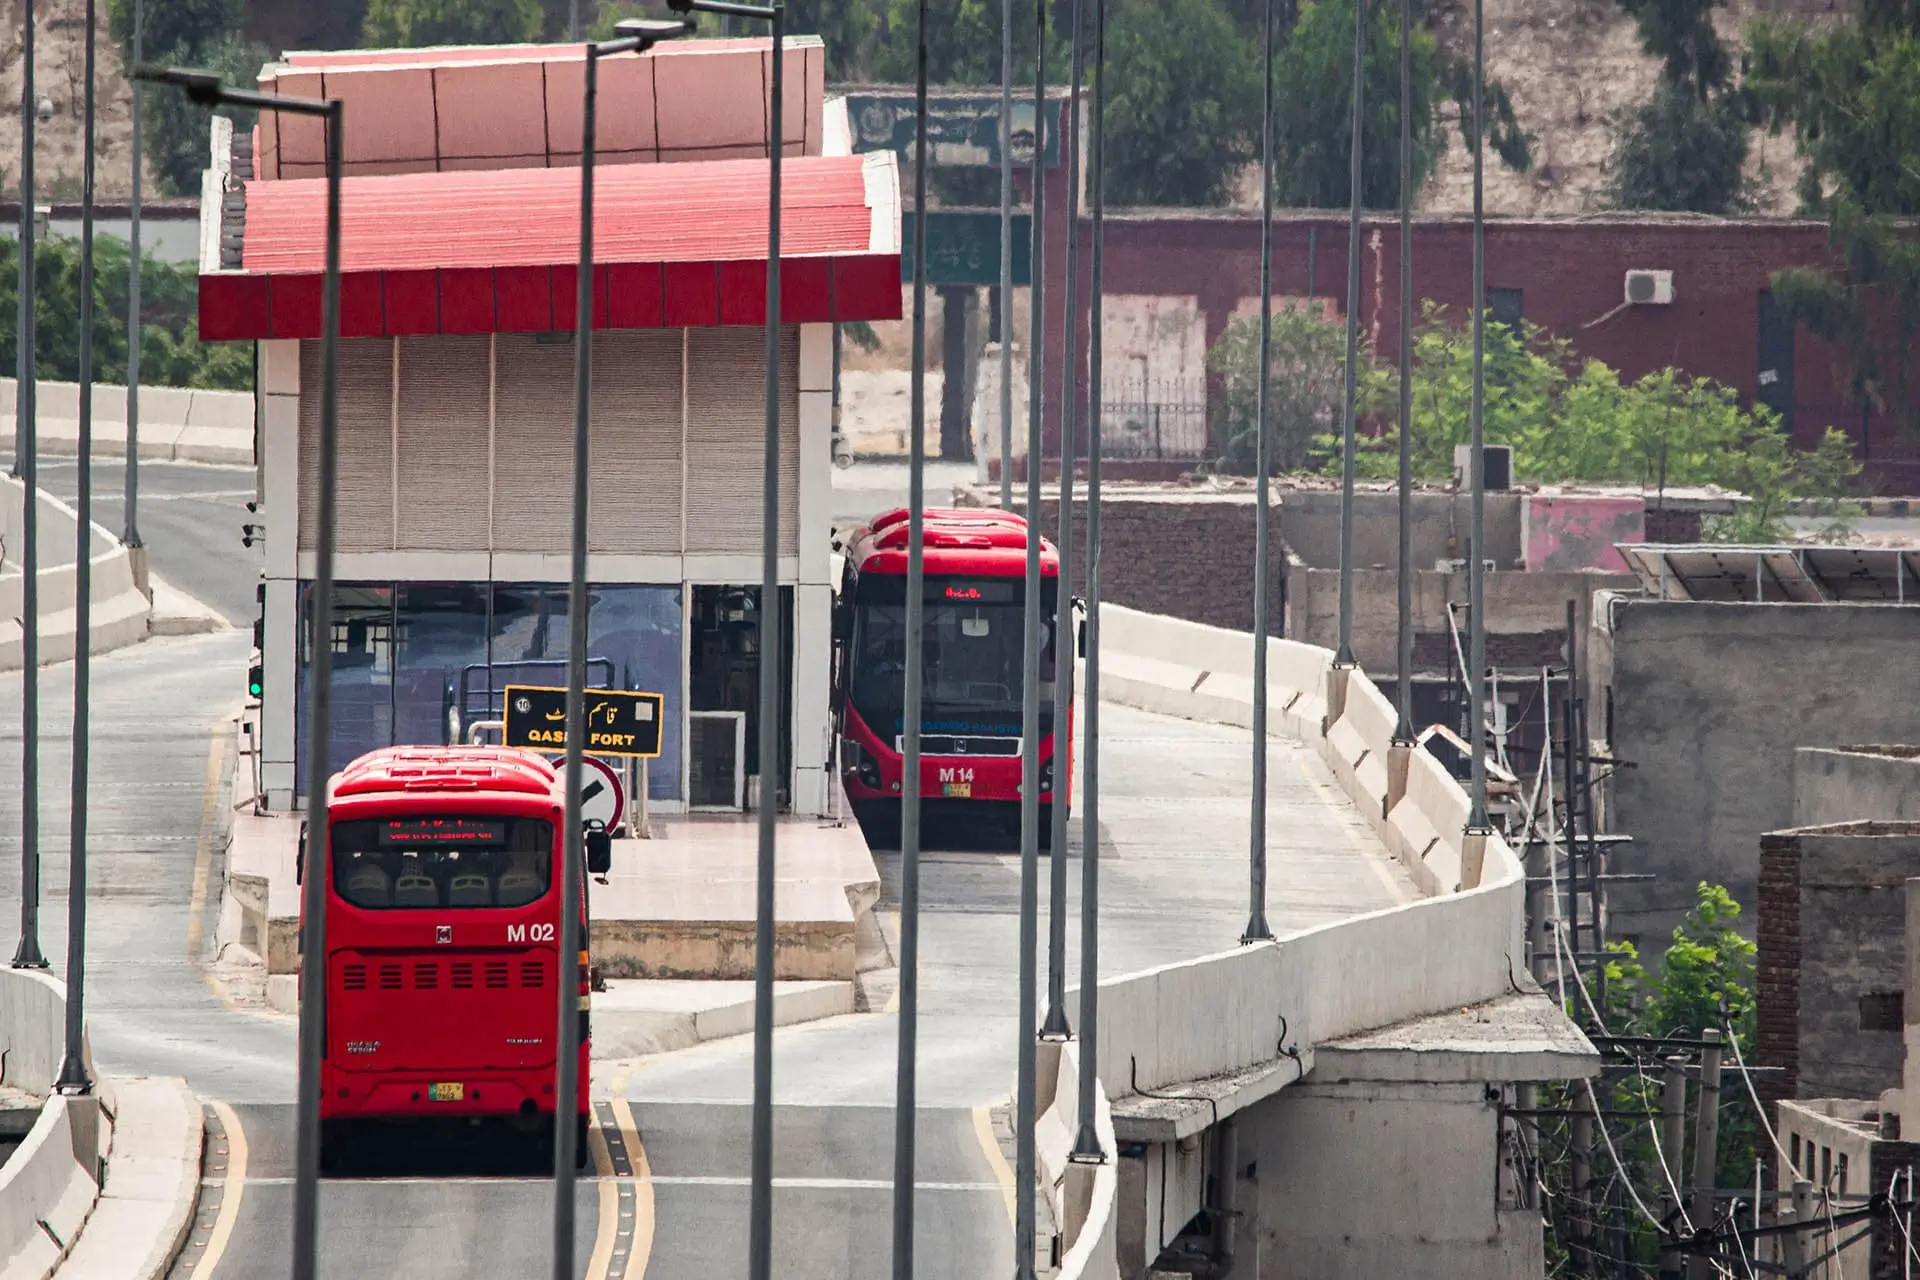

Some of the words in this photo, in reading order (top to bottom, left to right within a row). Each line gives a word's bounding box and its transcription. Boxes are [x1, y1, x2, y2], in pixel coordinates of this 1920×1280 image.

[528, 729, 570, 743] QASI
[590, 732, 636, 746] FORT
[940, 767, 955, 782] M
[957, 767, 974, 782] 14
[507, 923, 525, 942] M
[530, 922, 555, 942] 02
